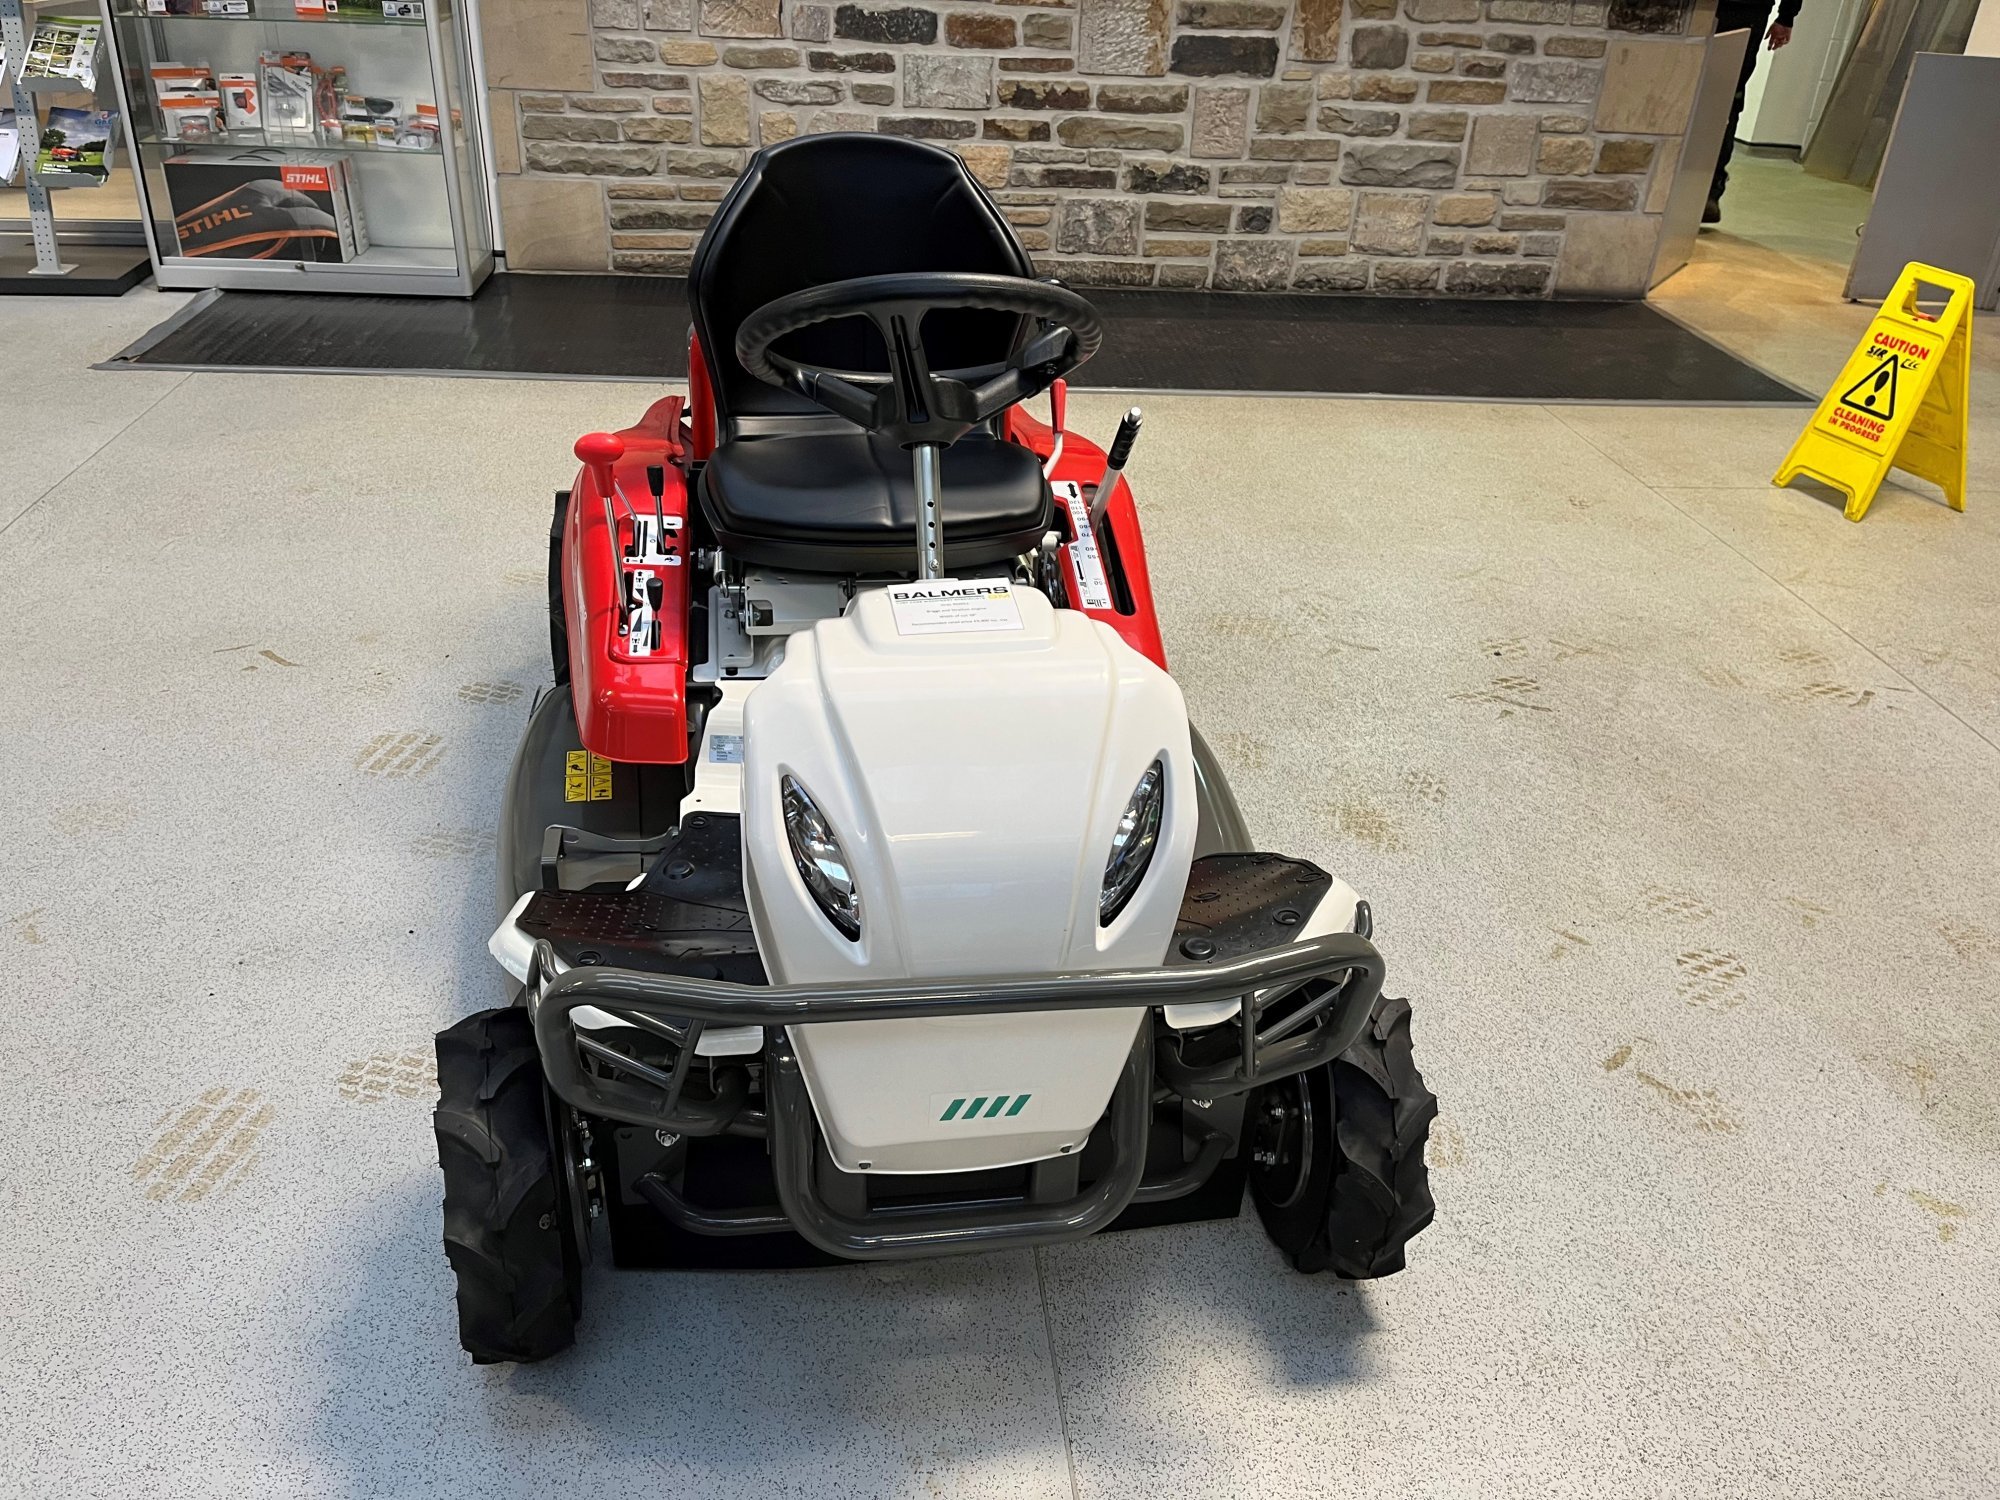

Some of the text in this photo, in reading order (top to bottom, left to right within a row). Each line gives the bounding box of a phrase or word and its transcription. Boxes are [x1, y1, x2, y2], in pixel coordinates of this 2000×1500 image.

[286, 173, 323, 185] STIHL
[177, 207, 253, 240] STIHL
[1873, 332, 1930, 360] CAUTION
[1828, 416, 1881, 442] IN PROGRESS
[1833, 407, 1885, 434] CLEANING
[894, 587, 1008, 600] BALMERS
